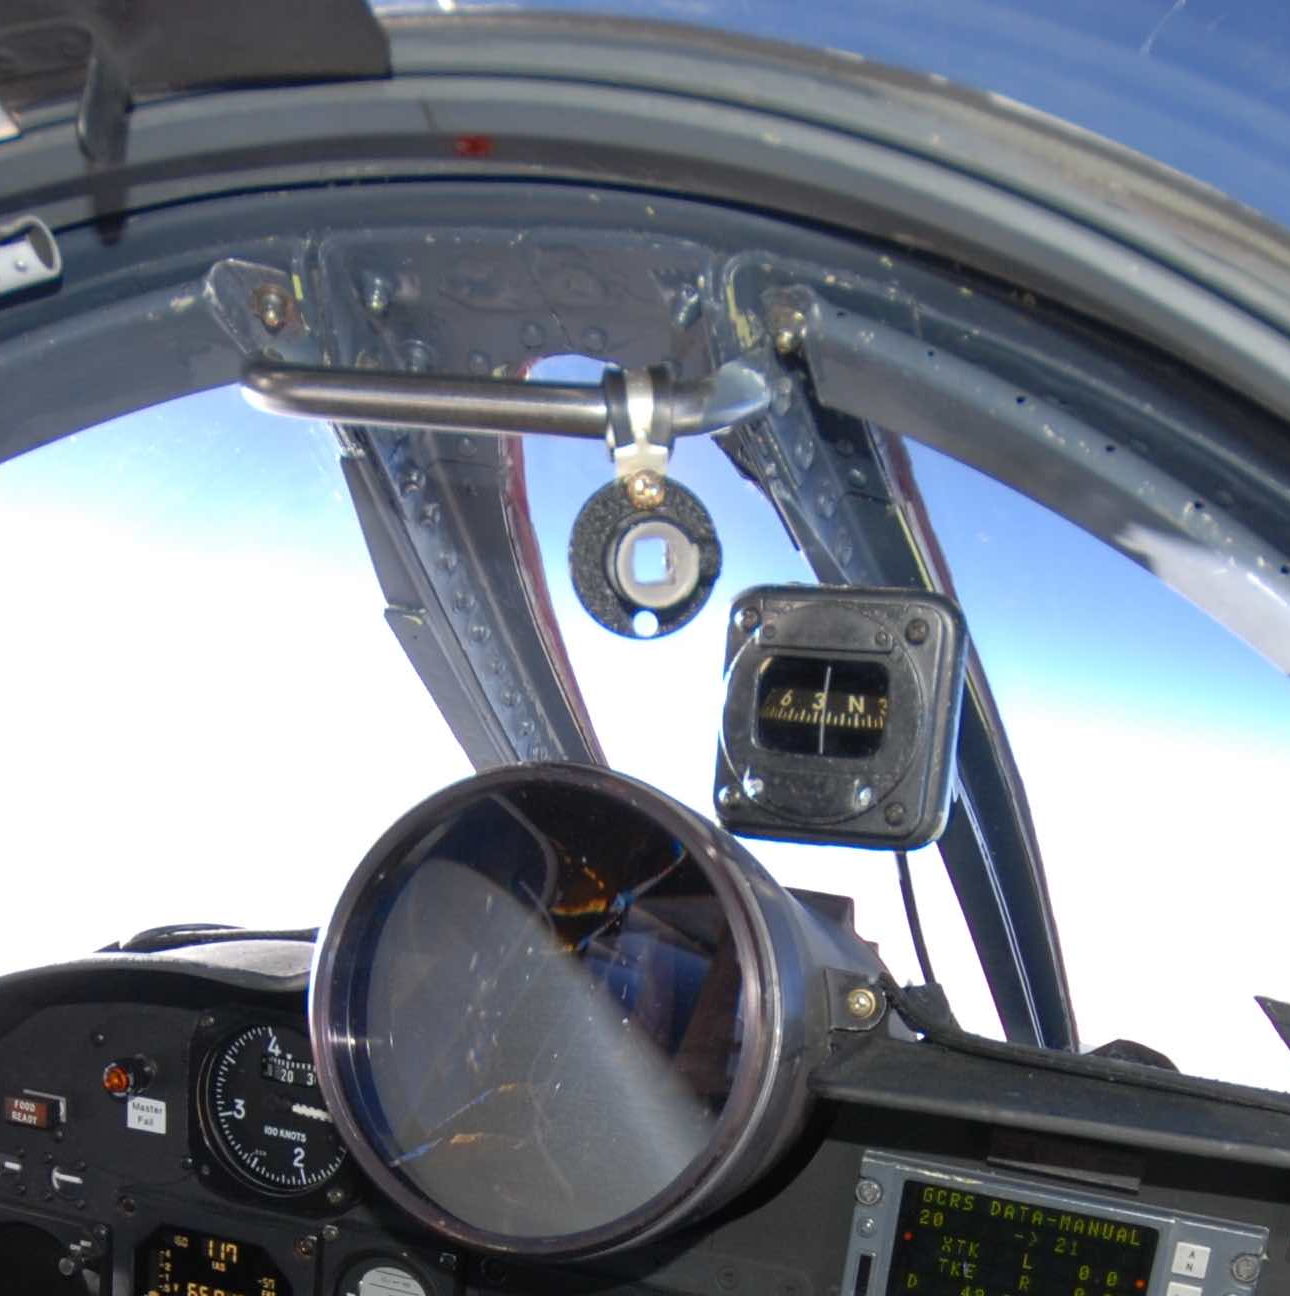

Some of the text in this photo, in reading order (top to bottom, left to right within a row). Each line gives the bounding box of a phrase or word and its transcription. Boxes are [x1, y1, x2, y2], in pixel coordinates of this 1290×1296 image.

[848, 695, 864, 713] N
[266, 1036, 282, 1057] 4
[280, 1069, 294, 1084] 20
[131, 1101, 163, 1115] Master
[232, 1098, 246, 1120] 3
[137, 1115, 155, 1127] Fail
[279, 1126, 307, 1142] KNOTS
[292, 1147, 306, 1168] 2
[918, 1208, 1079, 1257] 20 21
[989, 1199, 1142, 1247] DATA-MANUAL
[941, 1235, 1034, 1271] XTK L
[938, 1257, 1029, 1292] TKE R
